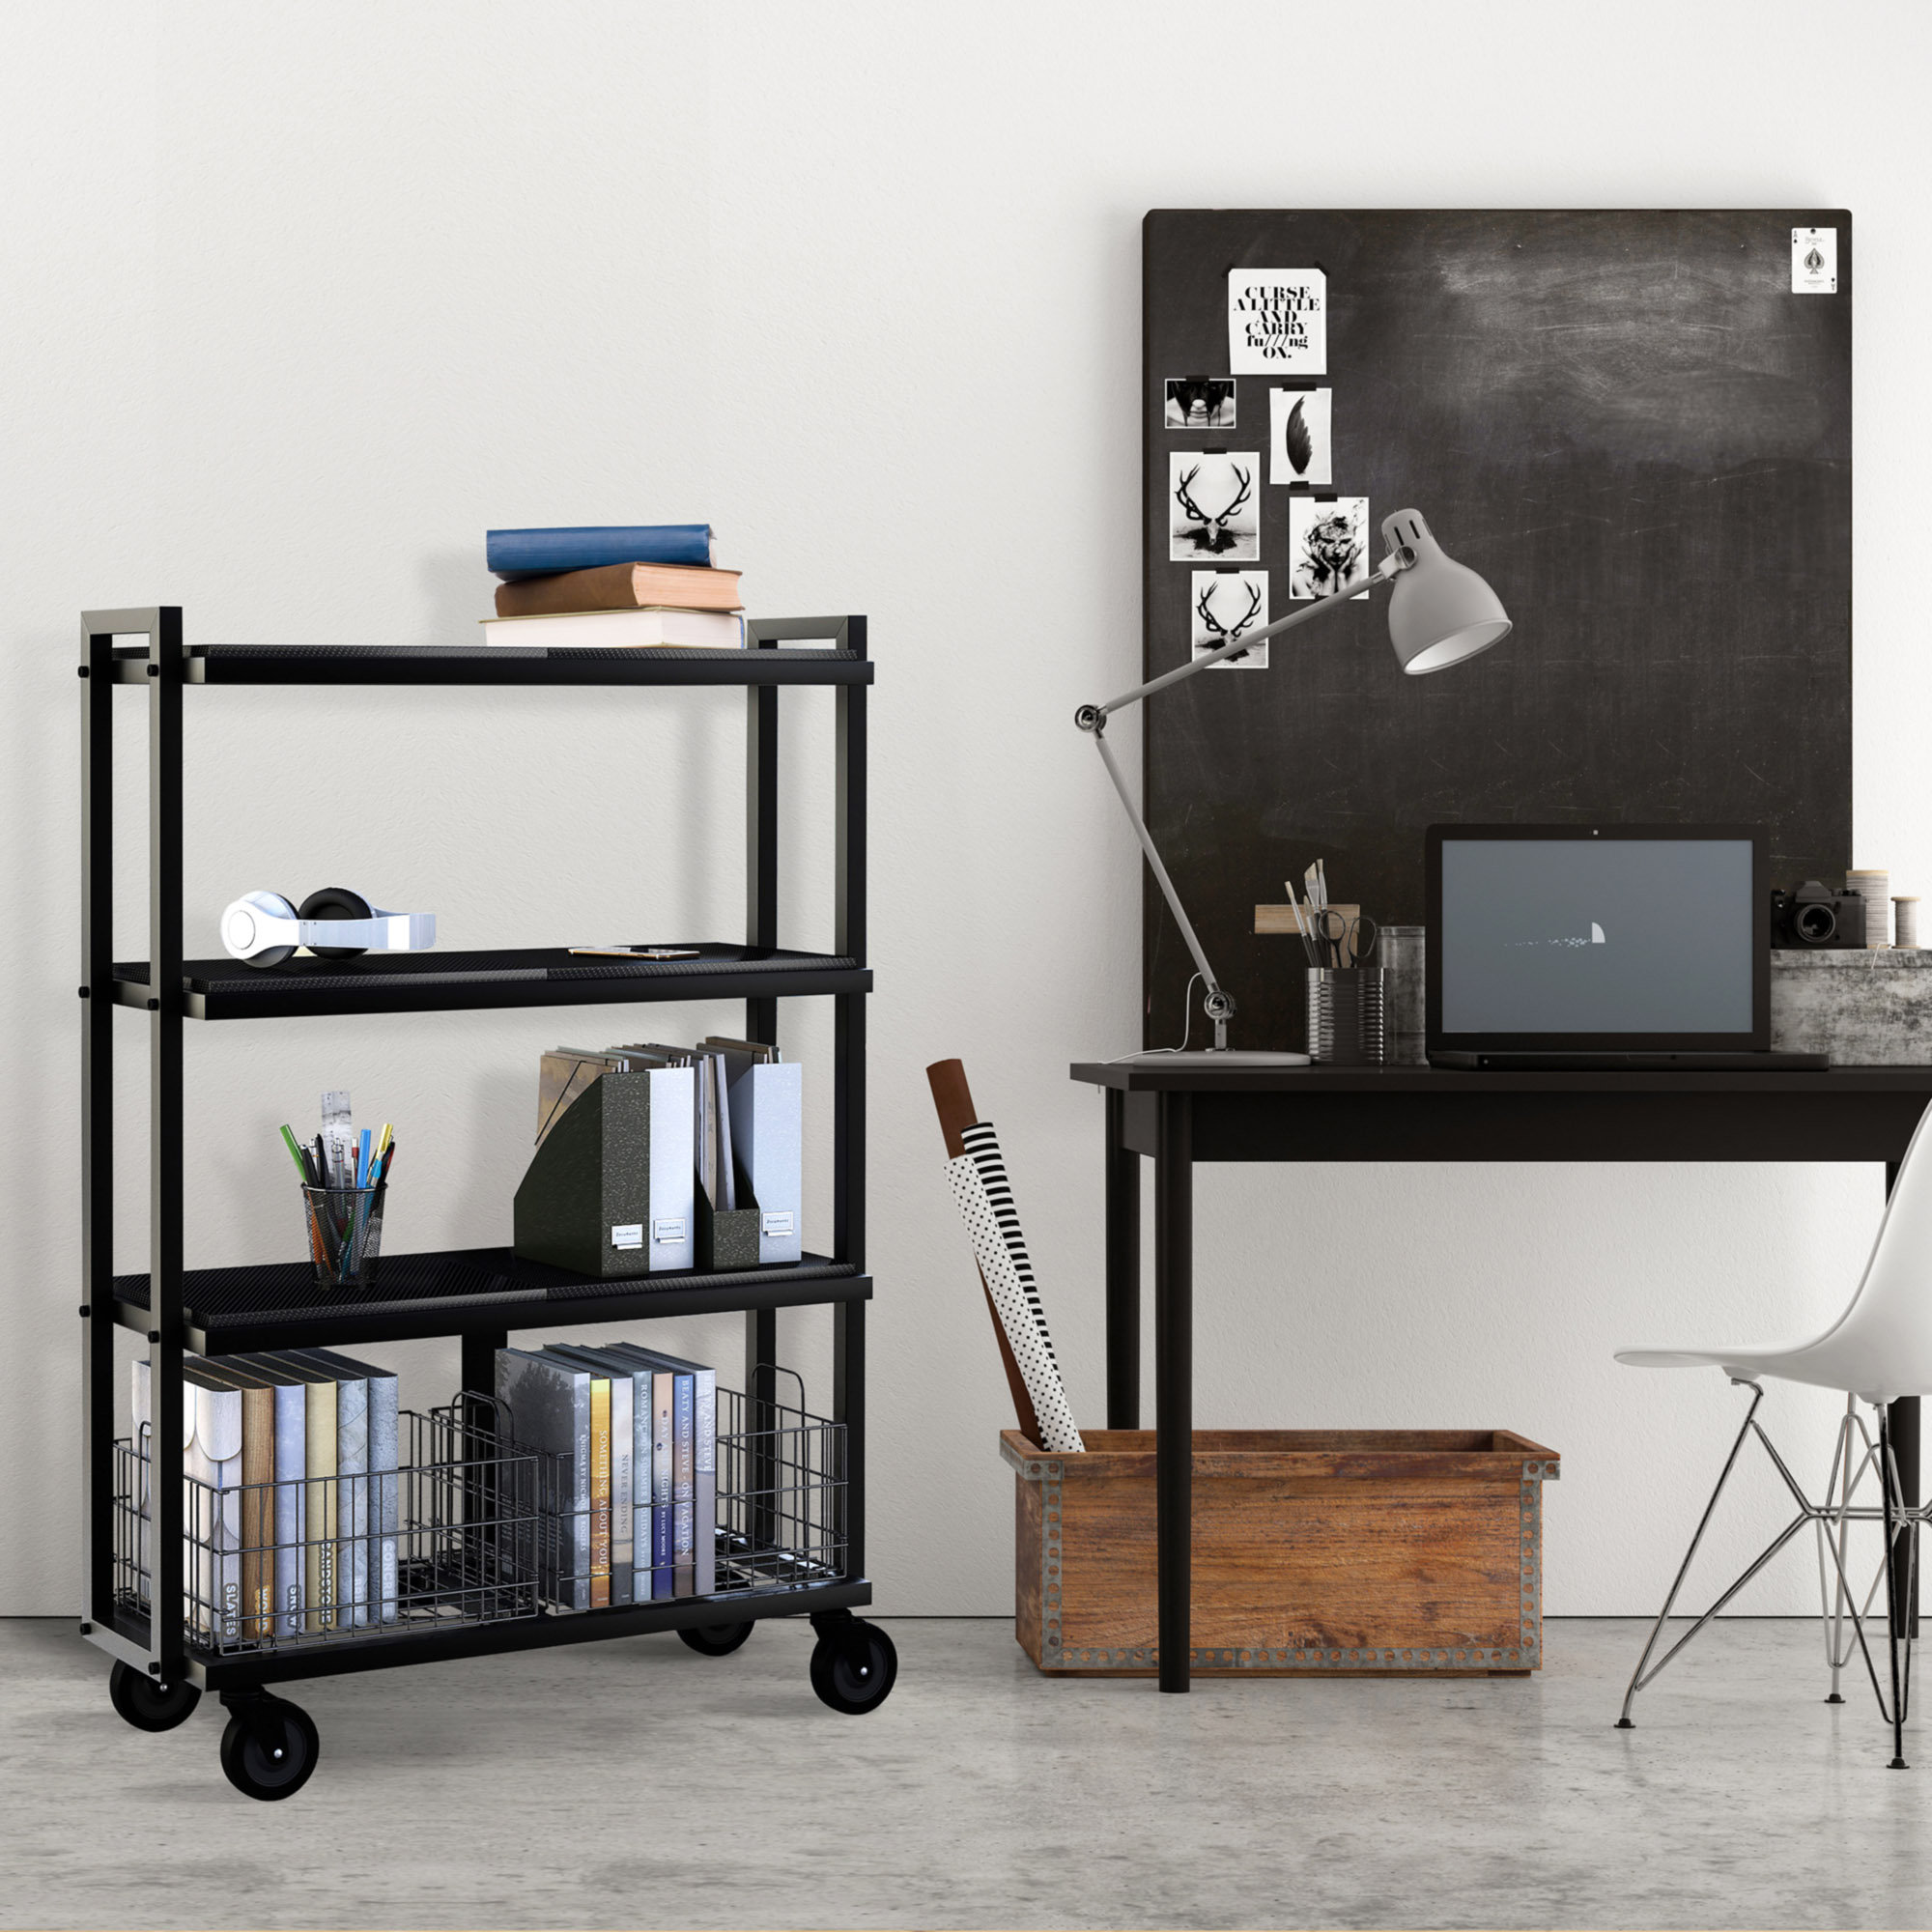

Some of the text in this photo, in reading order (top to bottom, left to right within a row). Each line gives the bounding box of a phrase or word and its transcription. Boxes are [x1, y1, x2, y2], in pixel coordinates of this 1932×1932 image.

[1244, 286, 1311, 299] CURSE
[1251, 298, 1321, 311] LITTLE
[1257, 310, 1297, 323] AND
[1245, 323, 1308, 335] CARRY
[1246, 333, 1309, 349] fu///ng
[599, 1430, 608, 1496] SOMETHING
[681, 1482, 689, 1497] ON
[599, 1539, 608, 1565] YOU
[384, 1542, 393, 1616] CONCREE
[354, 1577, 364, 1618] BRIK
